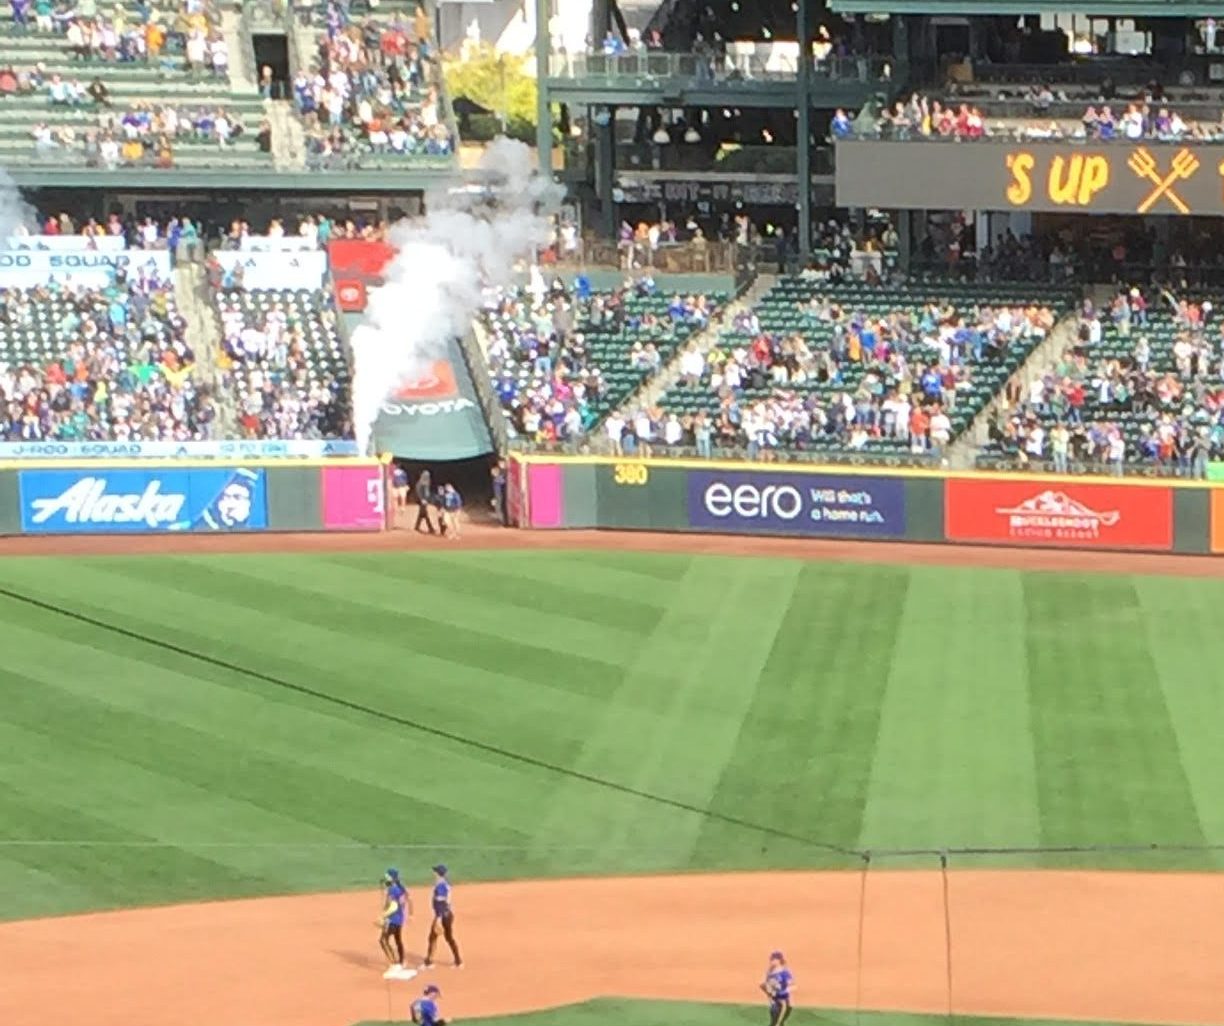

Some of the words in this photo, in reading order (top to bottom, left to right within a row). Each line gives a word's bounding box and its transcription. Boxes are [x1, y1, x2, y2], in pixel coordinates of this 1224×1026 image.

[1006, 153, 1034, 204] S
[1048, 155, 1109, 205] UP
[379, 398, 475, 416] OYOTA
[31, 477, 187, 528] Alaska
[705, 482, 802, 520] eero
